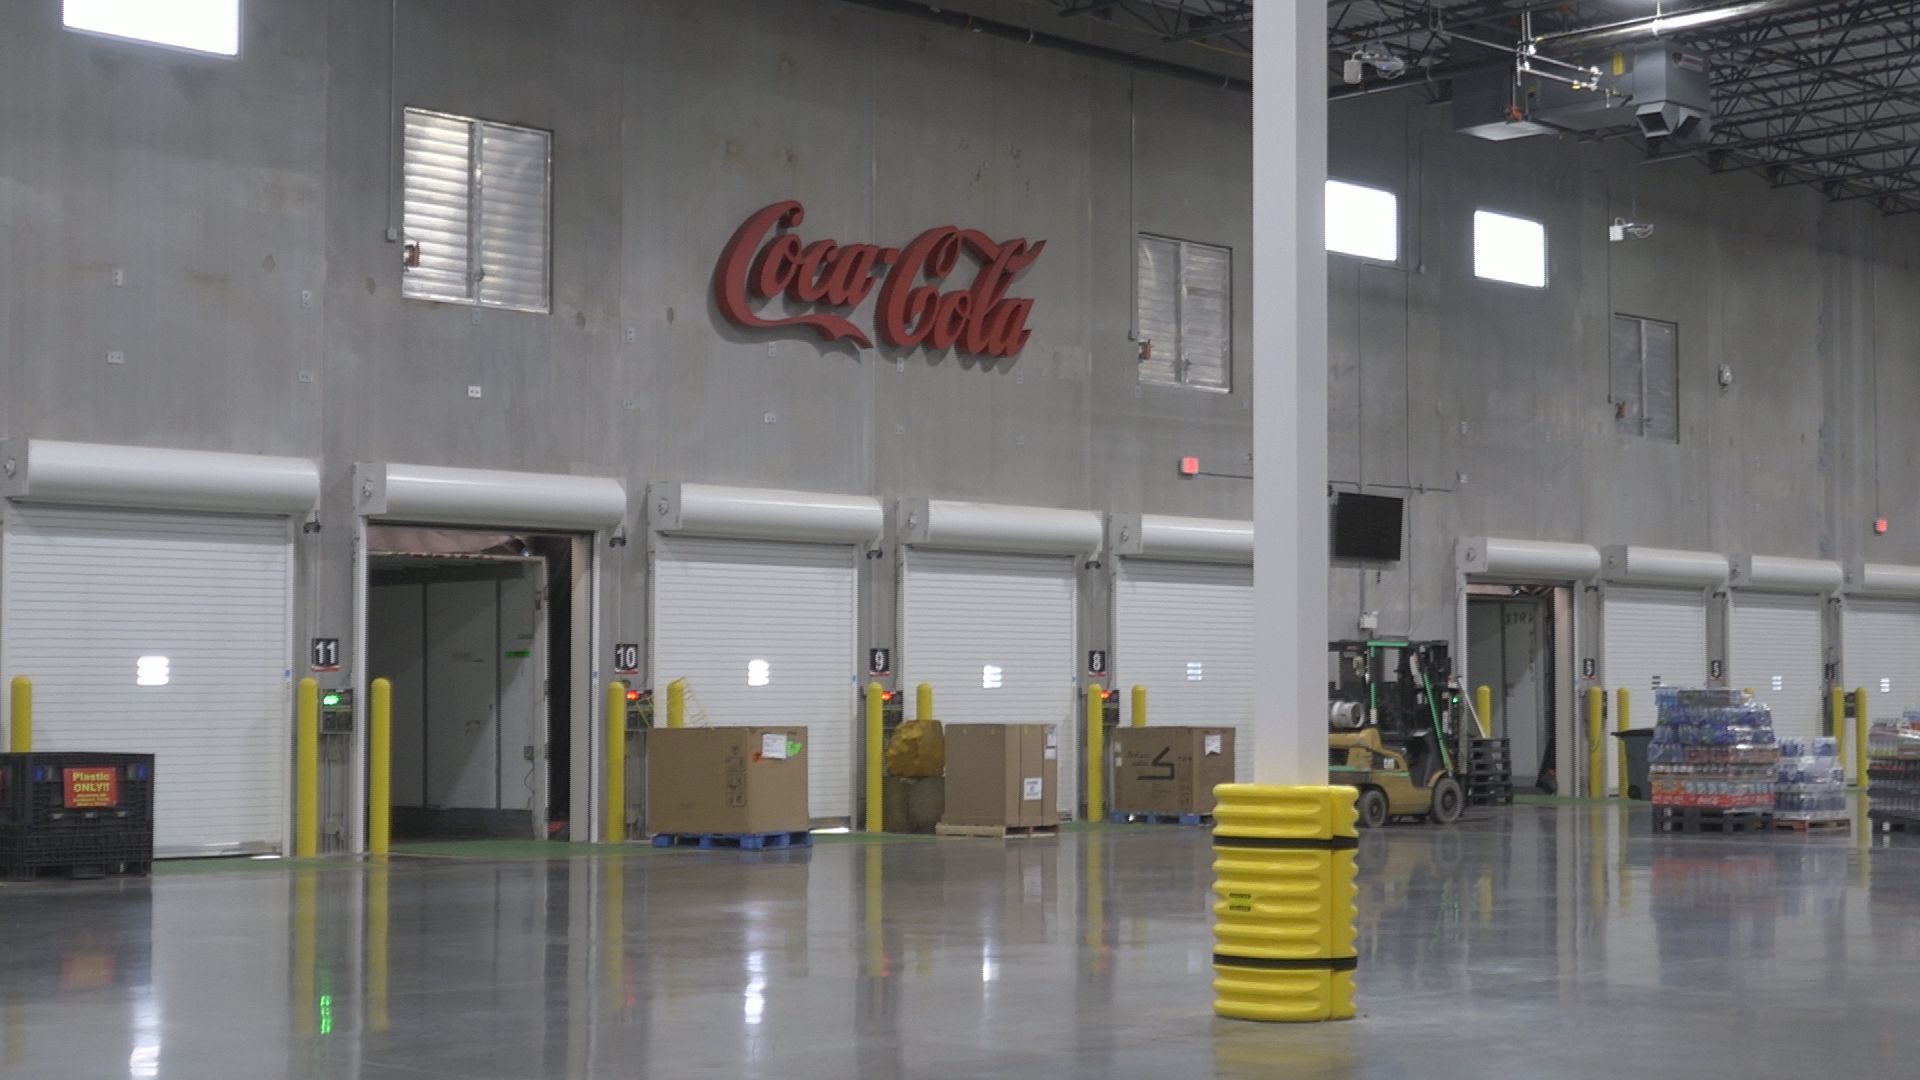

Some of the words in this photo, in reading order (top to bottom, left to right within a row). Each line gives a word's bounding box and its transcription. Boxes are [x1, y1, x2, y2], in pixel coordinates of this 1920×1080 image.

[714, 199, 1047, 358] Coca-Cola
[315, 641, 336, 664] 11
[616, 647, 636, 668] 10
[874, 651, 884, 671] 9
[1092, 653, 1101, 671] 8
[72, 771, 110, 782] Plastic
[72, 783, 110, 793] ONLY!!
